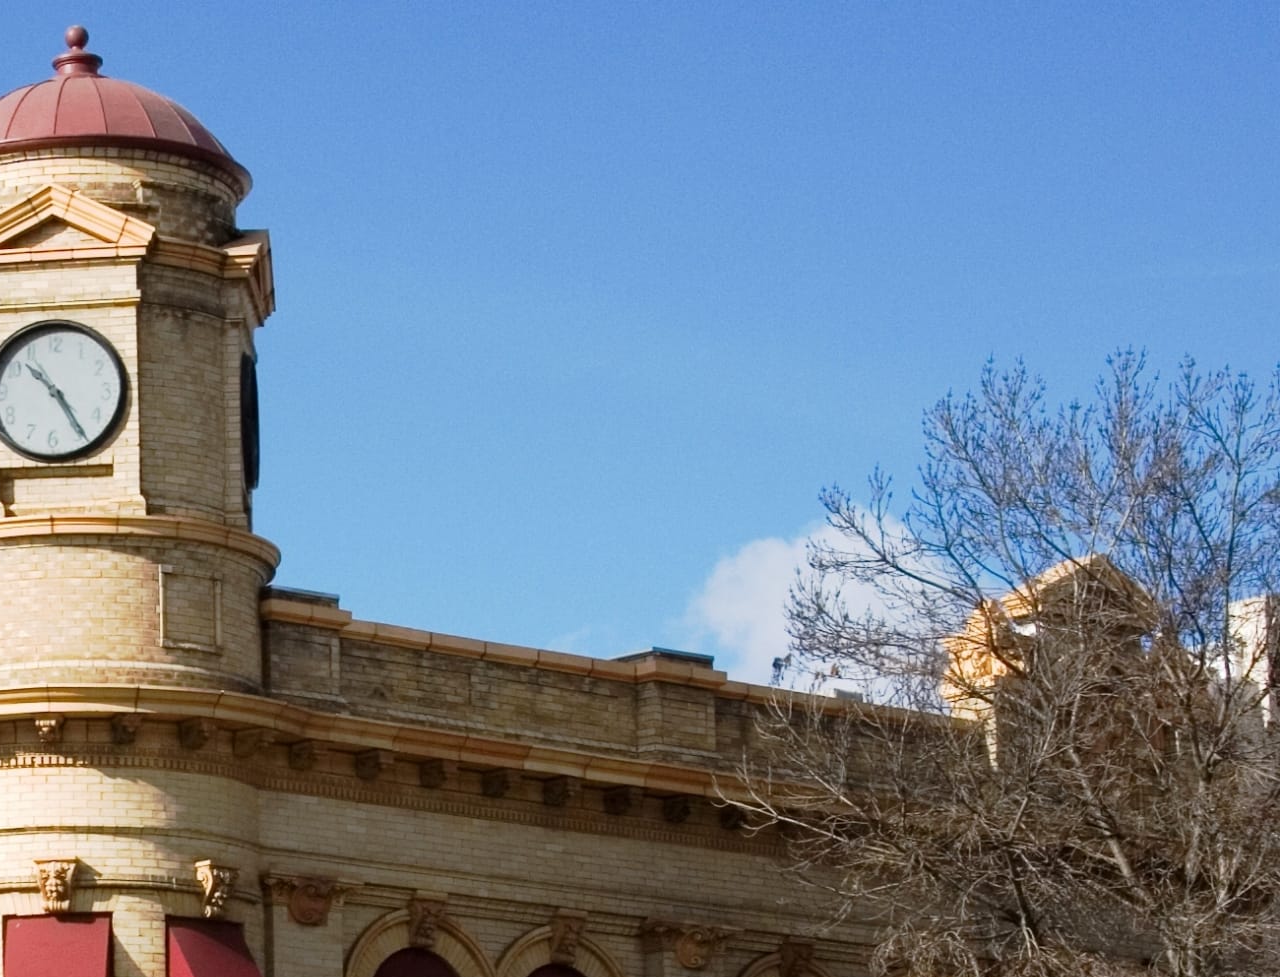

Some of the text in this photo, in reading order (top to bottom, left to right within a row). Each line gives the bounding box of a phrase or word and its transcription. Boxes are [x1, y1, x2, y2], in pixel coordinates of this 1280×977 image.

[27, 344, 37, 360] 11
[48, 337, 63, 353] 12
[9, 361, 22, 378] 10
[94, 360, 104, 376] 2
[101, 383, 111, 400] 3
[6, 407, 15, 425] 8
[92, 408, 101, 424] 4
[27, 424, 37, 440] 7
[47, 431, 58, 448] 6
